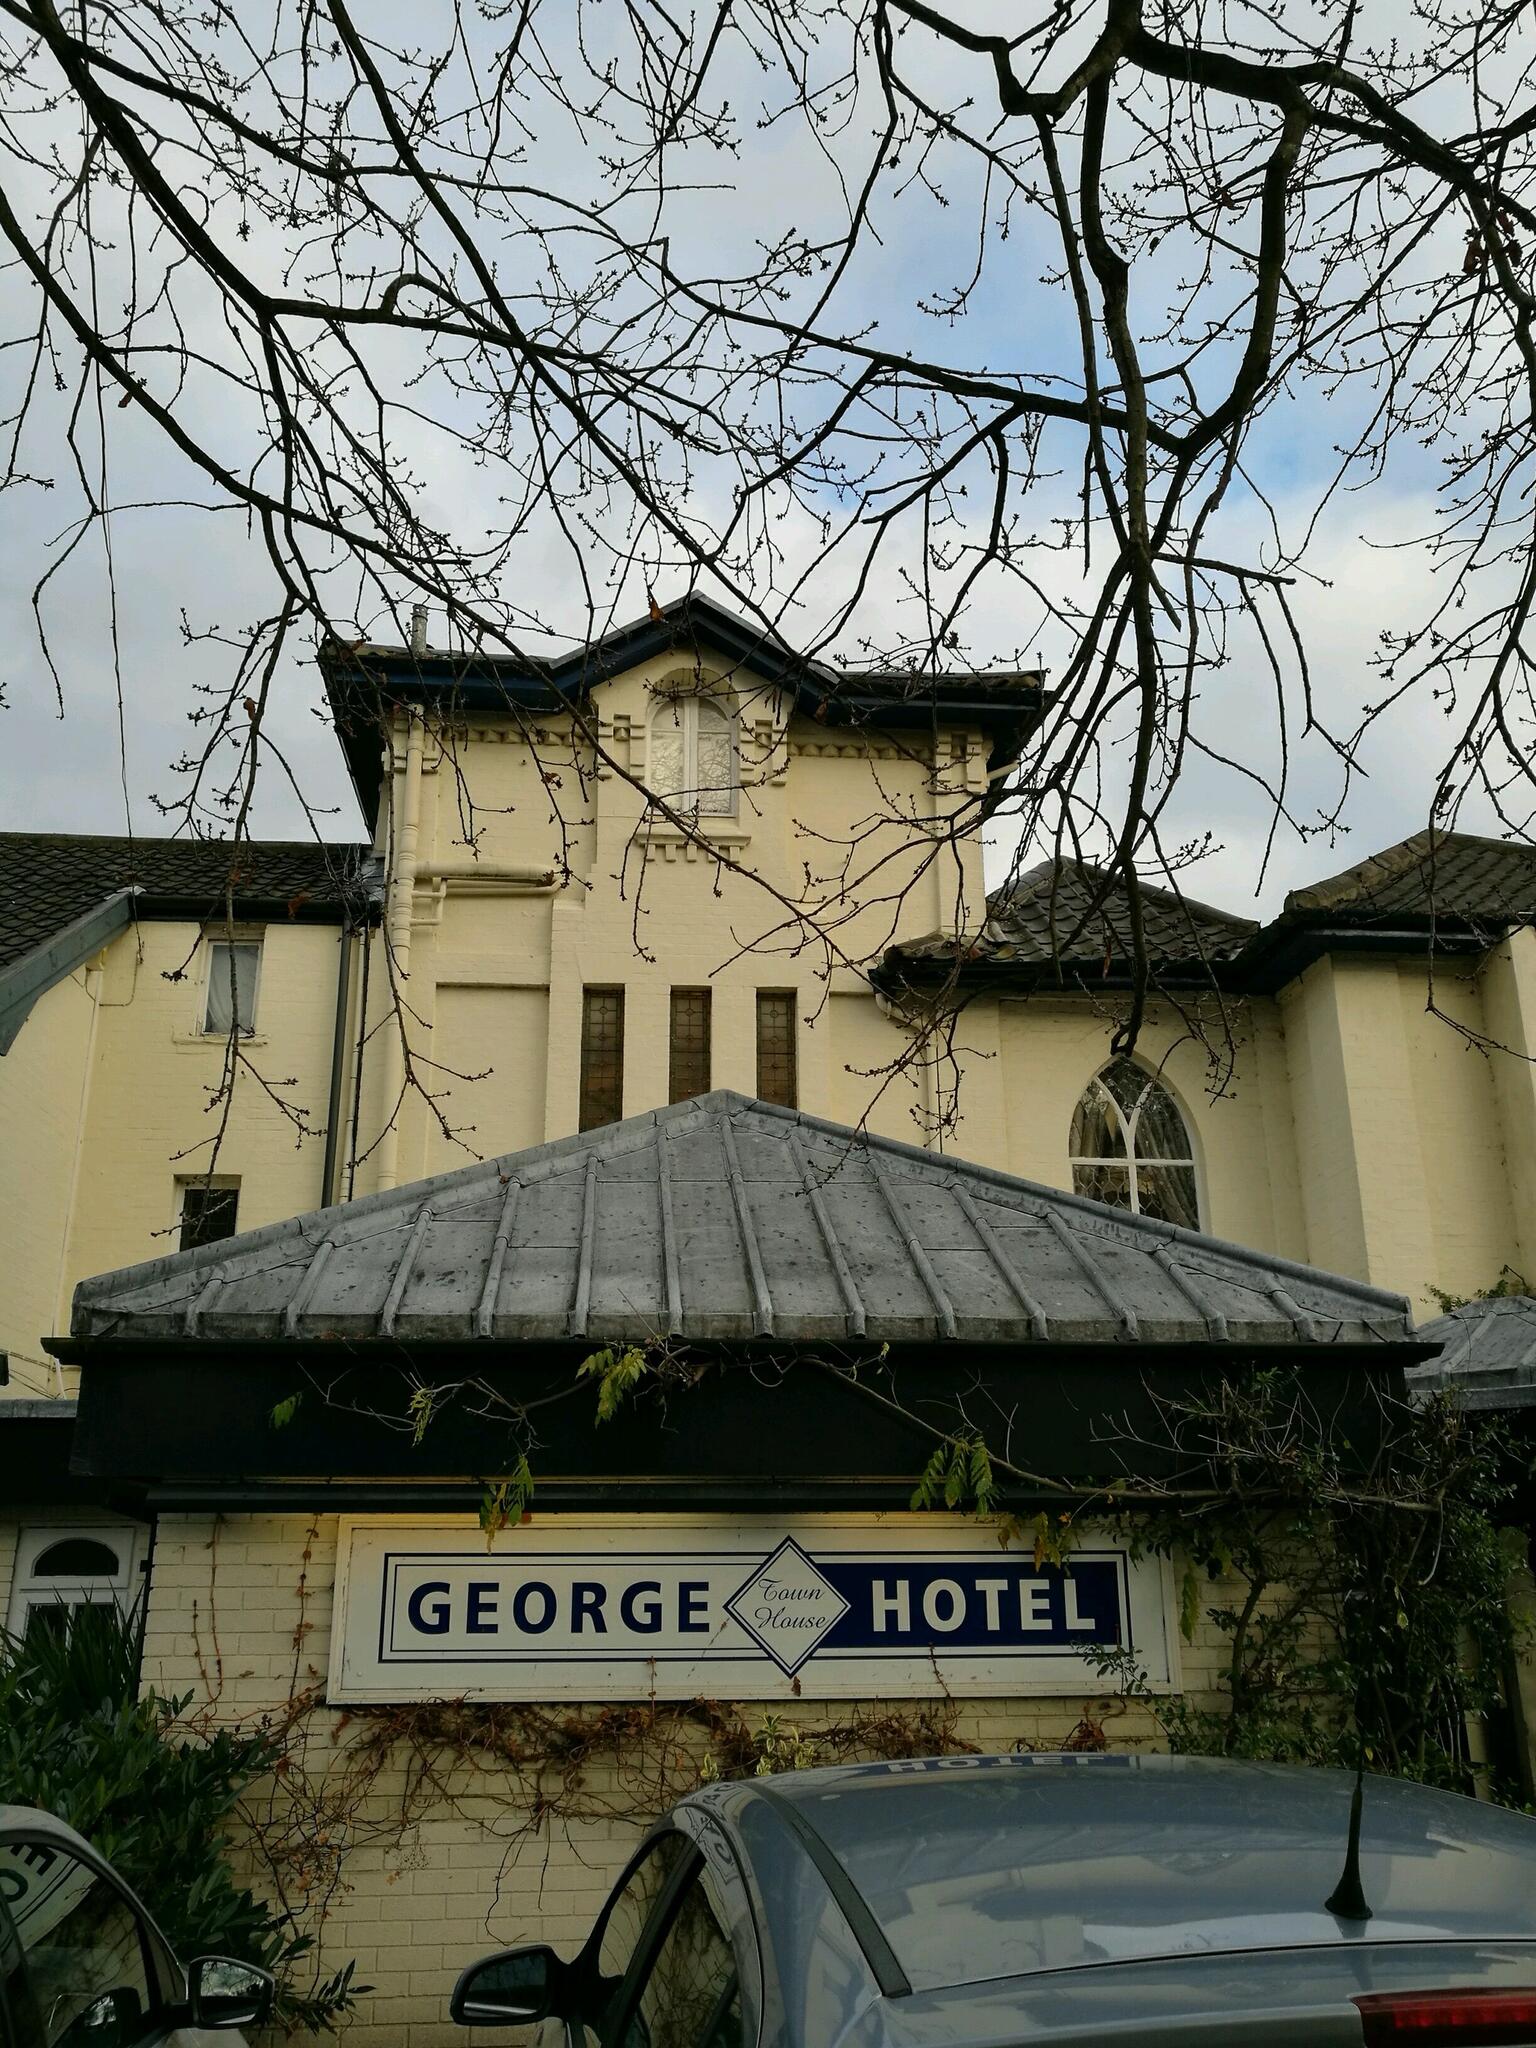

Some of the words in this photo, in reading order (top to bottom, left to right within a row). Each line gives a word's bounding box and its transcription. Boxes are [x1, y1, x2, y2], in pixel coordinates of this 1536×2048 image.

[757, 1578, 825, 1602] Town
[407, 1580, 710, 1635] GEORGE
[872, 1578, 1097, 1632] HOTEL
[754, 1606, 831, 1630] House
